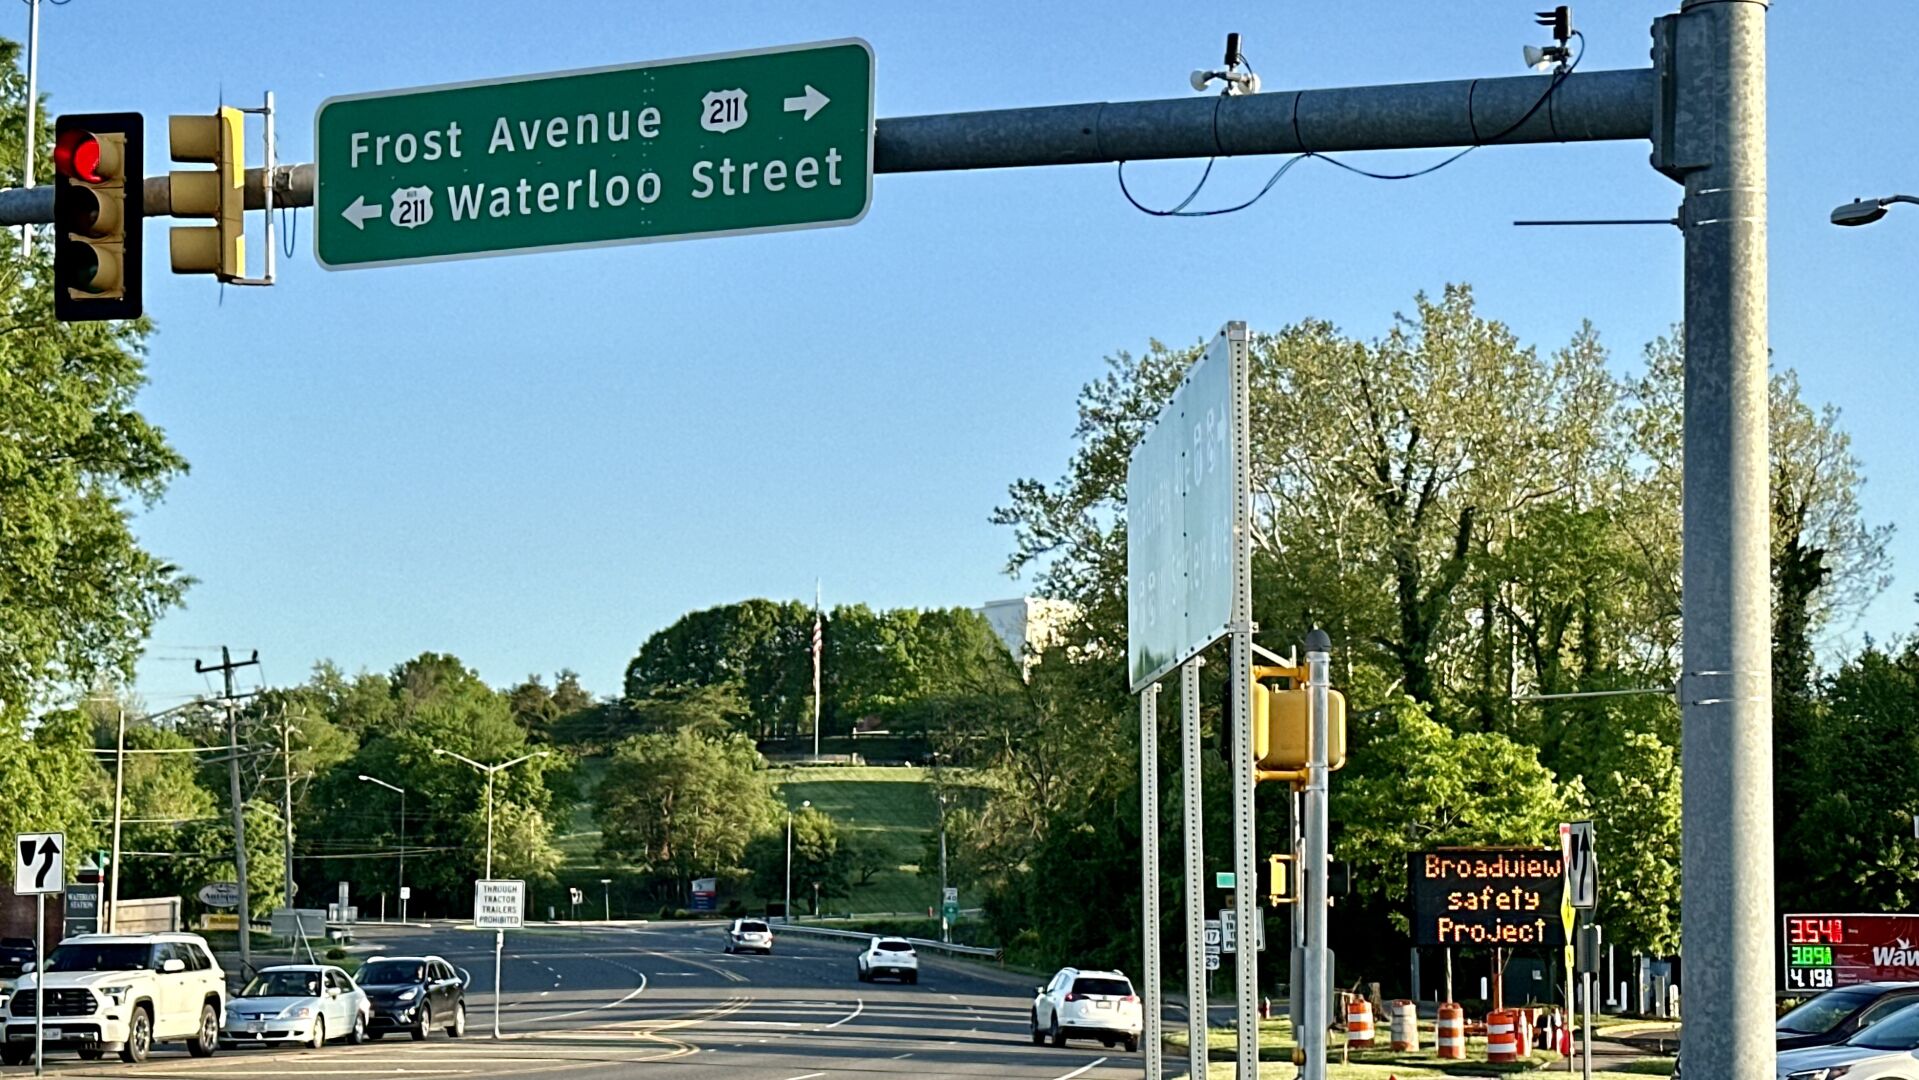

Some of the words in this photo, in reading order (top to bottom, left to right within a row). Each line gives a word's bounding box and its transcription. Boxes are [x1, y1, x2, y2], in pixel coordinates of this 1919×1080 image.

[350, 120, 463, 168] Frost
[488, 105, 662, 154] Avenue
[709, 96, 741, 125] 211
[399, 199, 425, 224] 211
[447, 169, 662, 222] Waterloo
[691, 147, 842, 199] Street
[1425, 854, 1561, 879] Broadview
[483, 885, 518, 893] THROUGH
[484, 895, 516, 903] TRACTOR
[1447, 886, 1540, 910] safety
[479, 916, 519, 924] PROHIBITED
[482, 905, 517, 913] TRAILERS
[1438, 918, 1546, 943] Project
